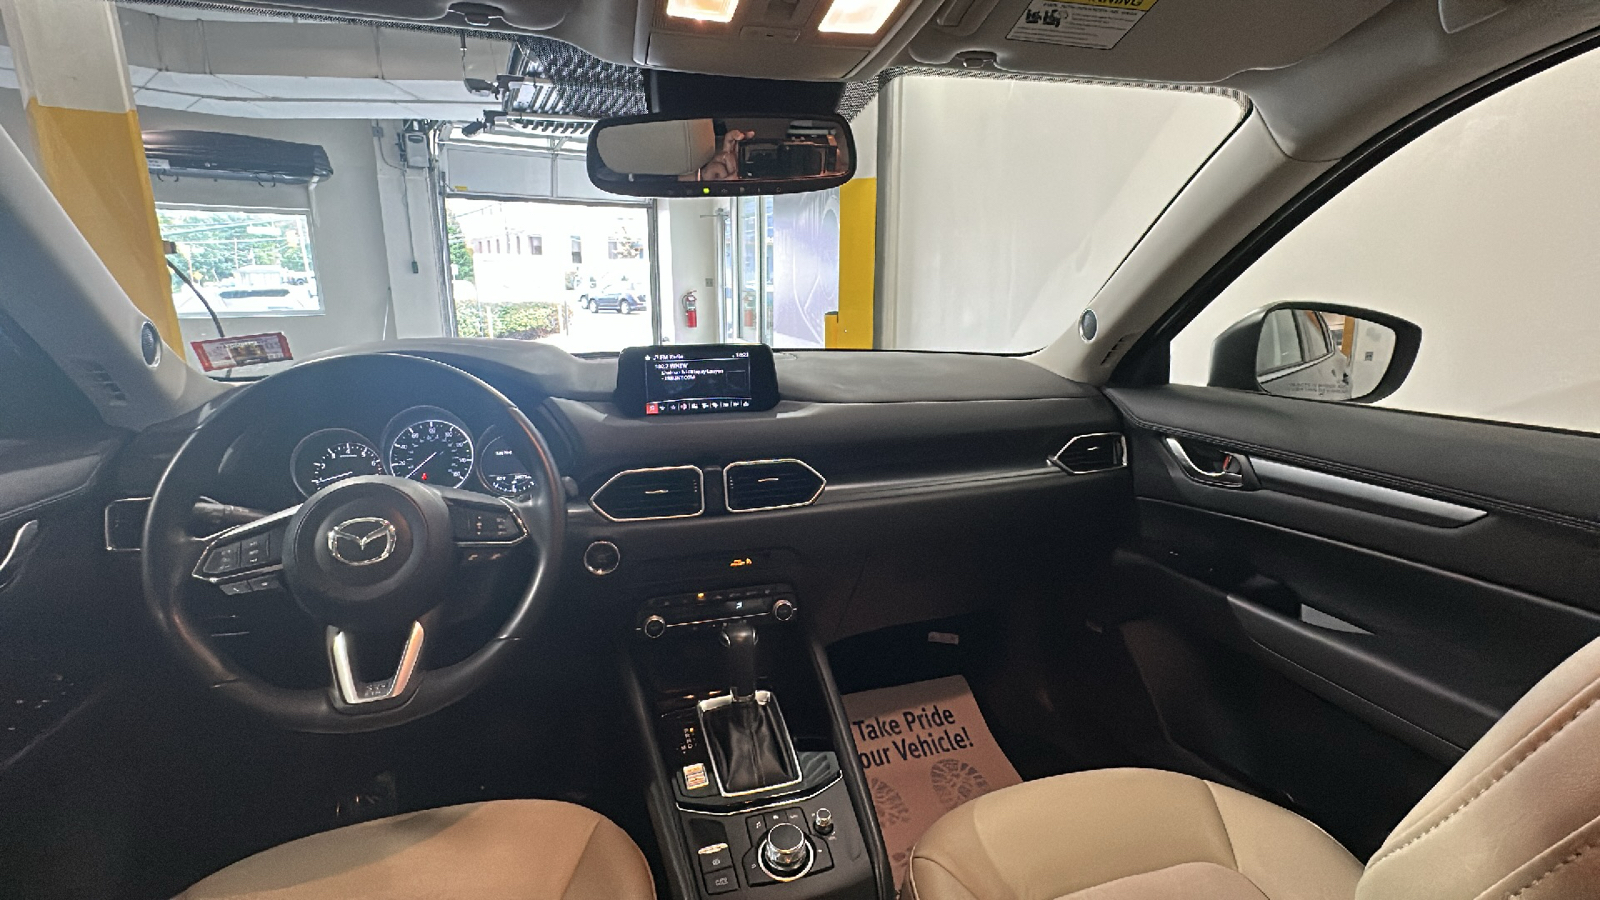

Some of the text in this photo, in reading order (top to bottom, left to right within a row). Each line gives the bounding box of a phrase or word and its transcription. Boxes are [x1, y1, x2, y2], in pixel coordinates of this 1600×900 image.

[853, 705, 955, 741] Take Pride
[858, 727, 974, 769] our Vehicle!
